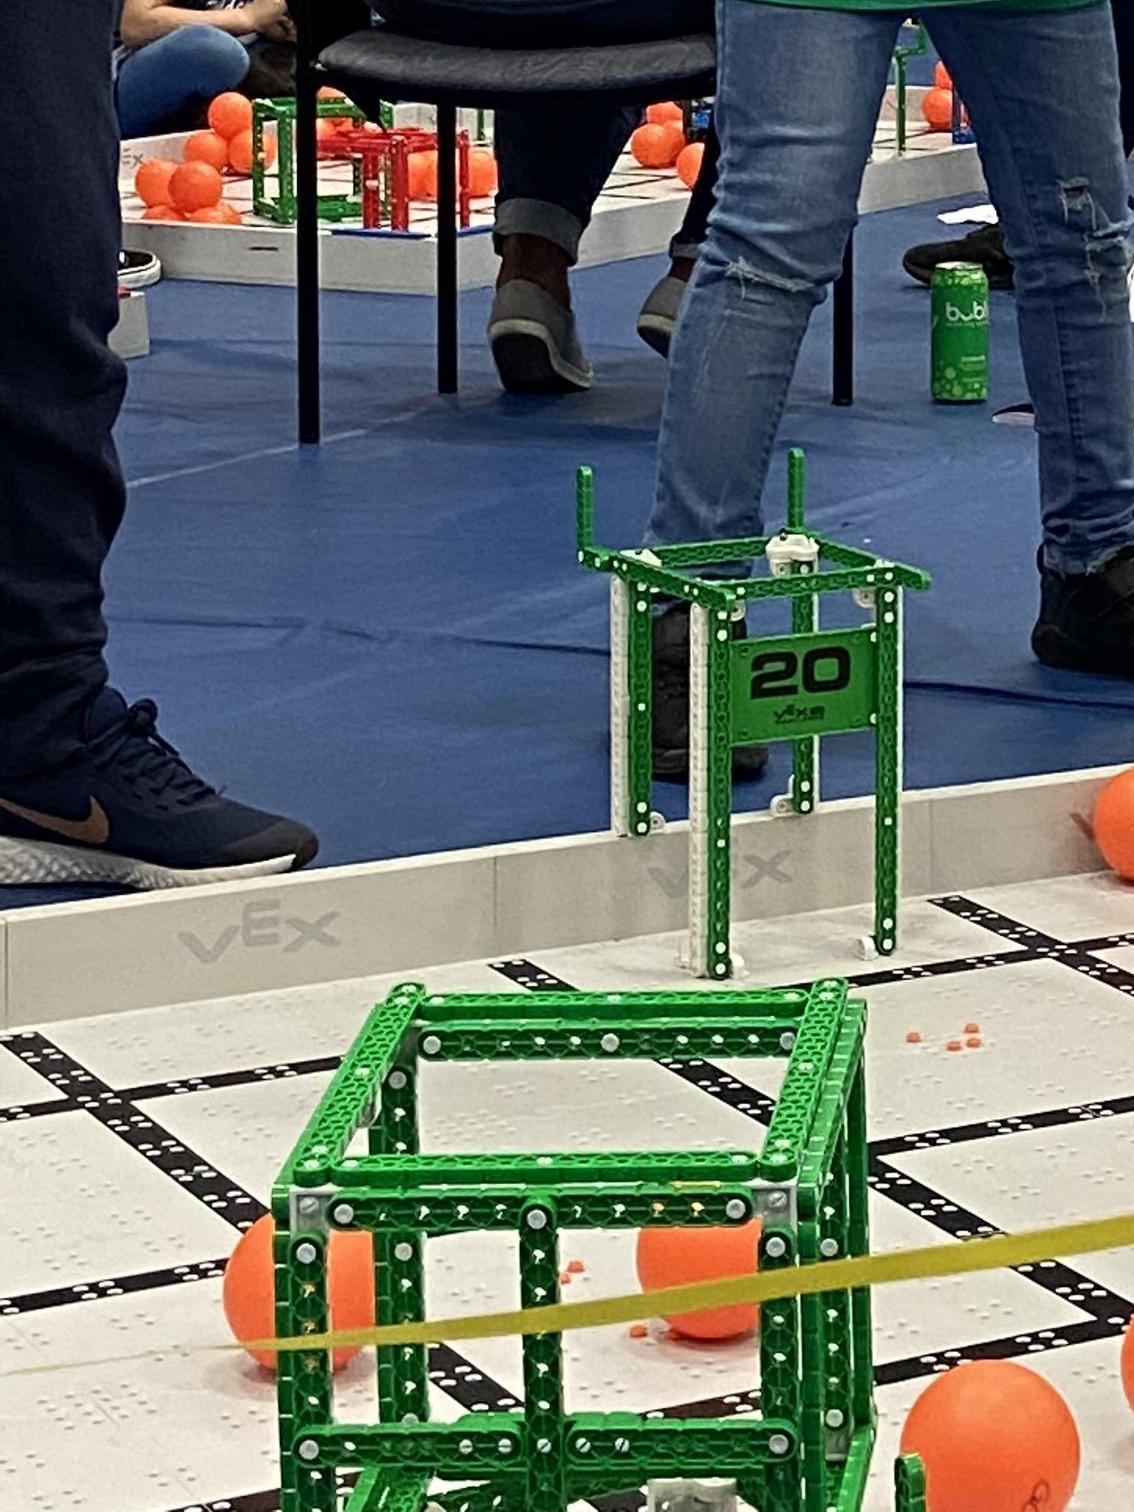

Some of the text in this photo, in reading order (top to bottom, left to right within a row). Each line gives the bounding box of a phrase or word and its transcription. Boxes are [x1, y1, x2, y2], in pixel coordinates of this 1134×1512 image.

[751, 646, 851, 699] 20
[648, 848, 794, 899] VX
[178, 899, 342, 964] VEX
